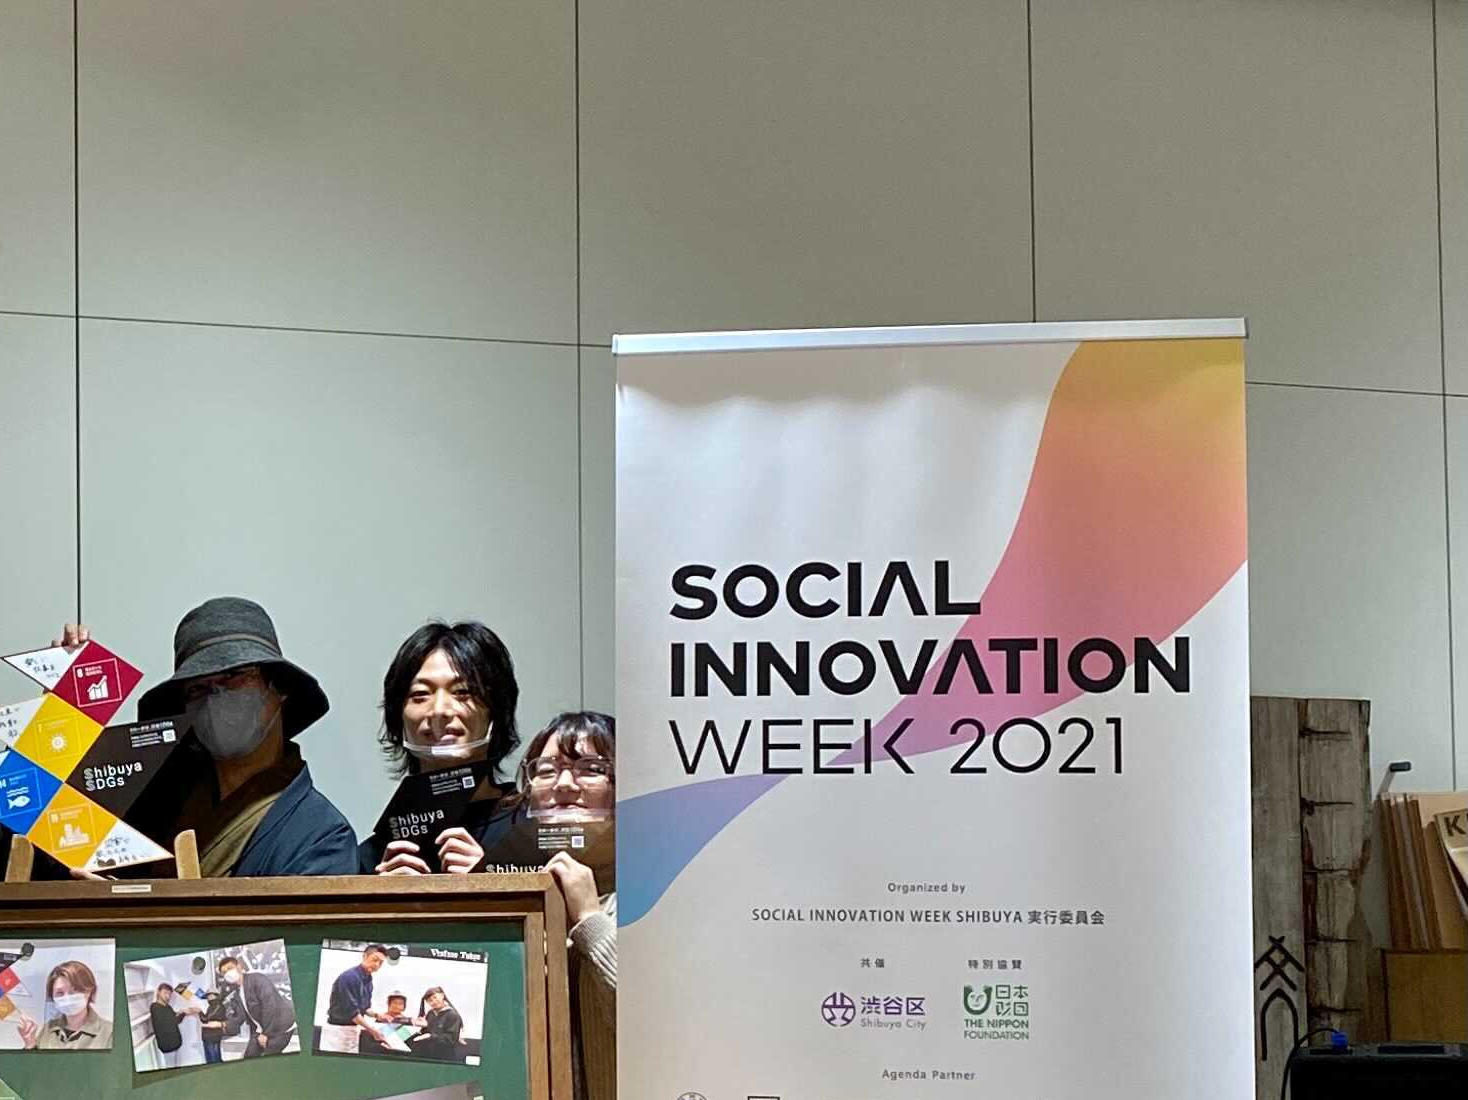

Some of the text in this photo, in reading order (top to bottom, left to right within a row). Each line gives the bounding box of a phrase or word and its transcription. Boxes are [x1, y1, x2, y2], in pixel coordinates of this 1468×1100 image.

[669, 560, 982, 620] SOCIAL
[670, 636, 1191, 697] INNOVATION
[668, 717, 1124, 775] WEEK 2021
[83, 761, 144, 781] Shibuya
[84, 776, 125, 792] SDGs
[389, 808, 444, 828] Shibuya
[392, 824, 428, 840] SDGs
[887, 882, 966, 895] Organized by
[752, 908, 1106, 926] SOCIAL INNOVATION WEEK SHIBUYA 実行委員会
[860, 996, 926, 1016] 渋谷区
[860, 1018, 926, 1031] Shibuya City
[963, 1019, 1029, 1029] THE NIPPON
[963, 1030, 1029, 1040] FOUNDATION
[882, 1069, 976, 1081] Agenda Partner
